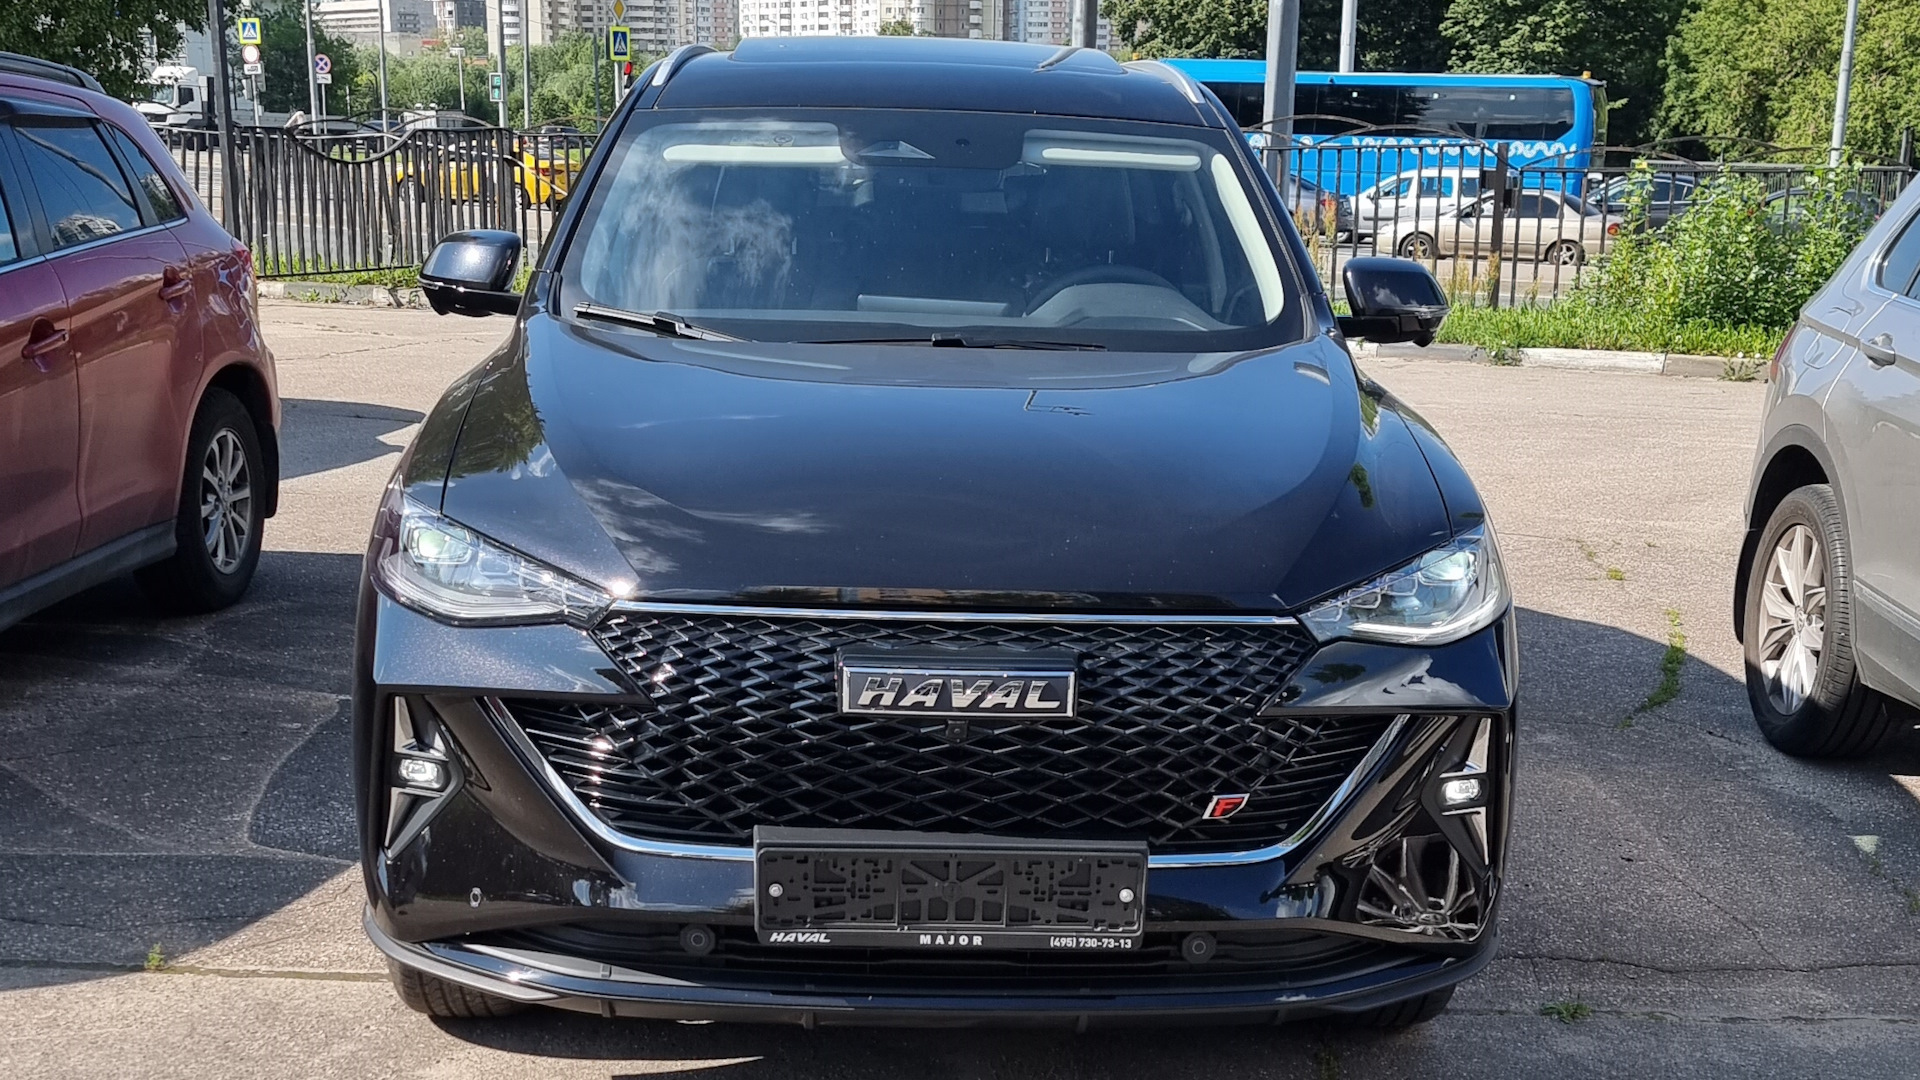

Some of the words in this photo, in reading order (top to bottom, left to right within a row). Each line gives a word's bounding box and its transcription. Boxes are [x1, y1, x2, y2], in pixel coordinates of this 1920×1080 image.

[857, 676, 1061, 709] HAVAL
[1211, 796, 1245, 818] F
[769, 932, 831, 943] HAVAL
[919, 934, 983, 946] MAJOR
[1050, 936, 1077, 948] (495)
[1078, 937, 1132, 949] 730-73-13
